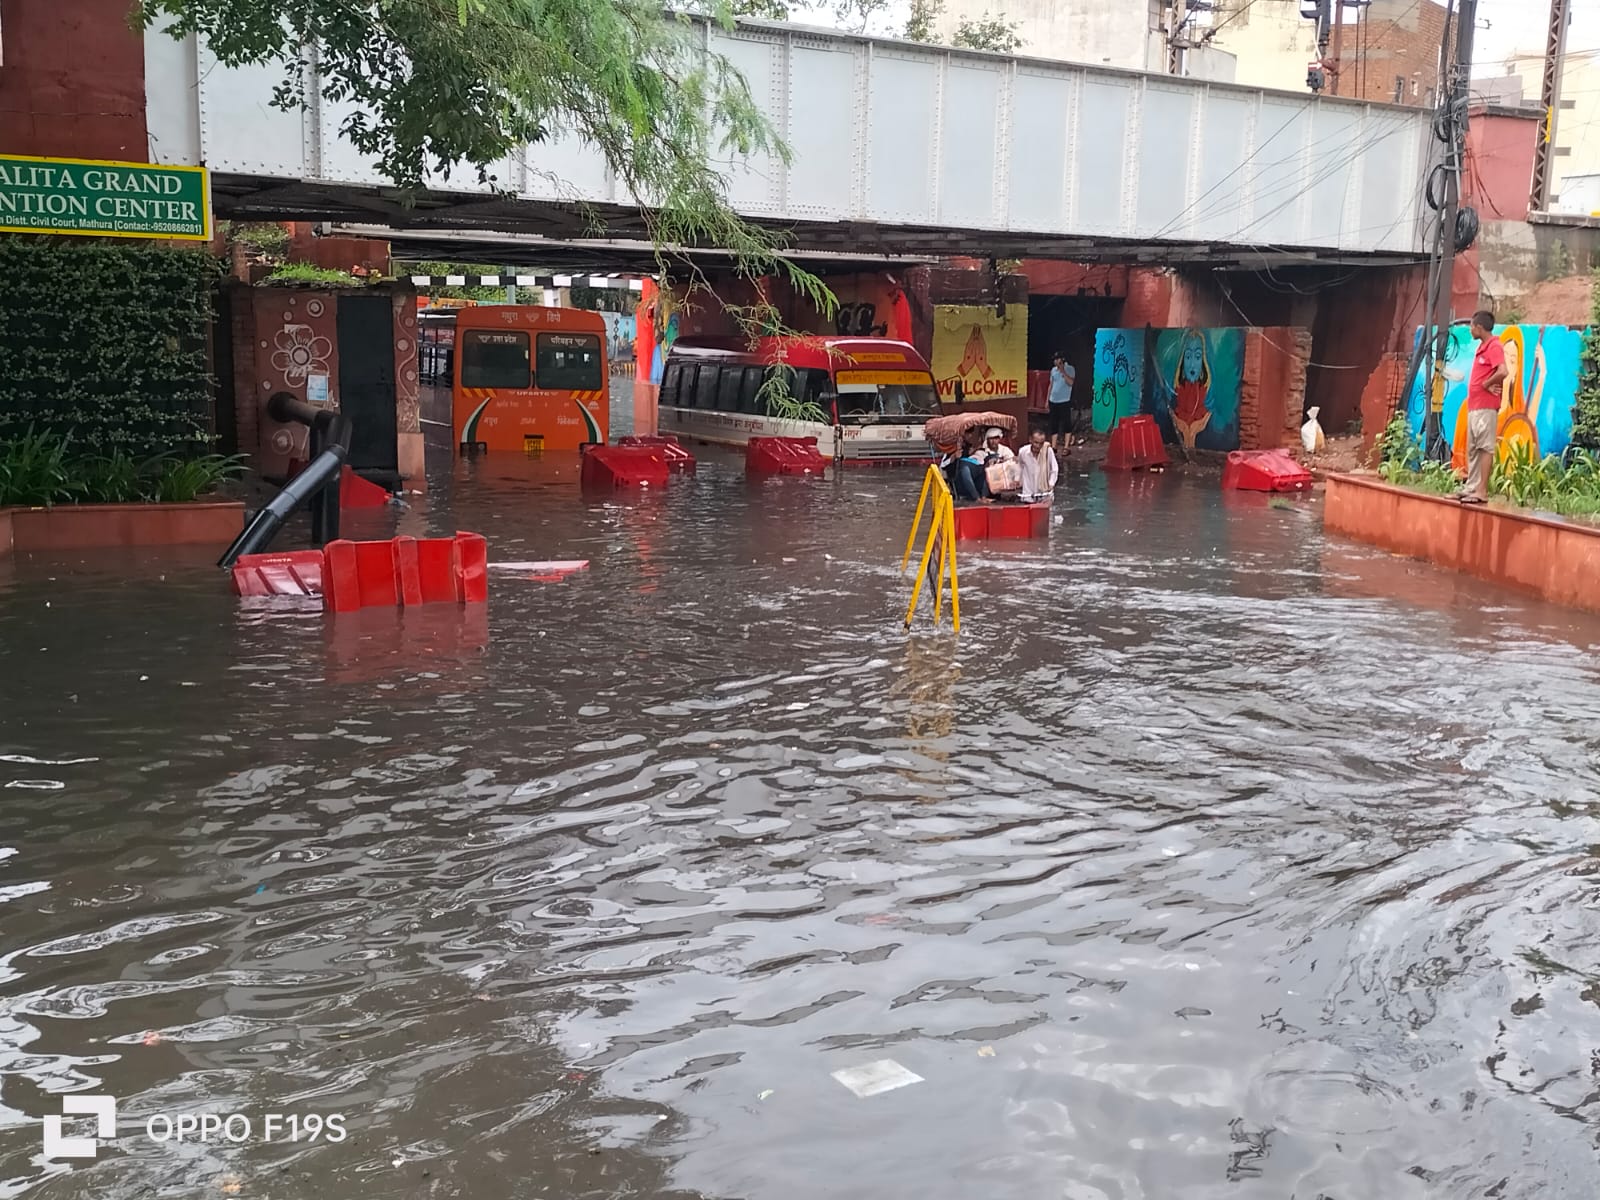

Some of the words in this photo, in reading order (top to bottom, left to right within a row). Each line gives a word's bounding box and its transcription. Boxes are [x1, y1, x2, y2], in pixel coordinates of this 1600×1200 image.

[0, 165, 77, 189] ALITA
[83, 170, 182, 195] GRAND
[0, 192, 88, 215] NTION
[95, 197, 198, 221] CENTER
[6, 215, 29, 225] Distt.
[30, 216, 50, 226] Civil
[51, 217, 77, 228] Court,
[79, 218, 113, 229] Mathura
[936, 379, 1018, 396] WLCOME
